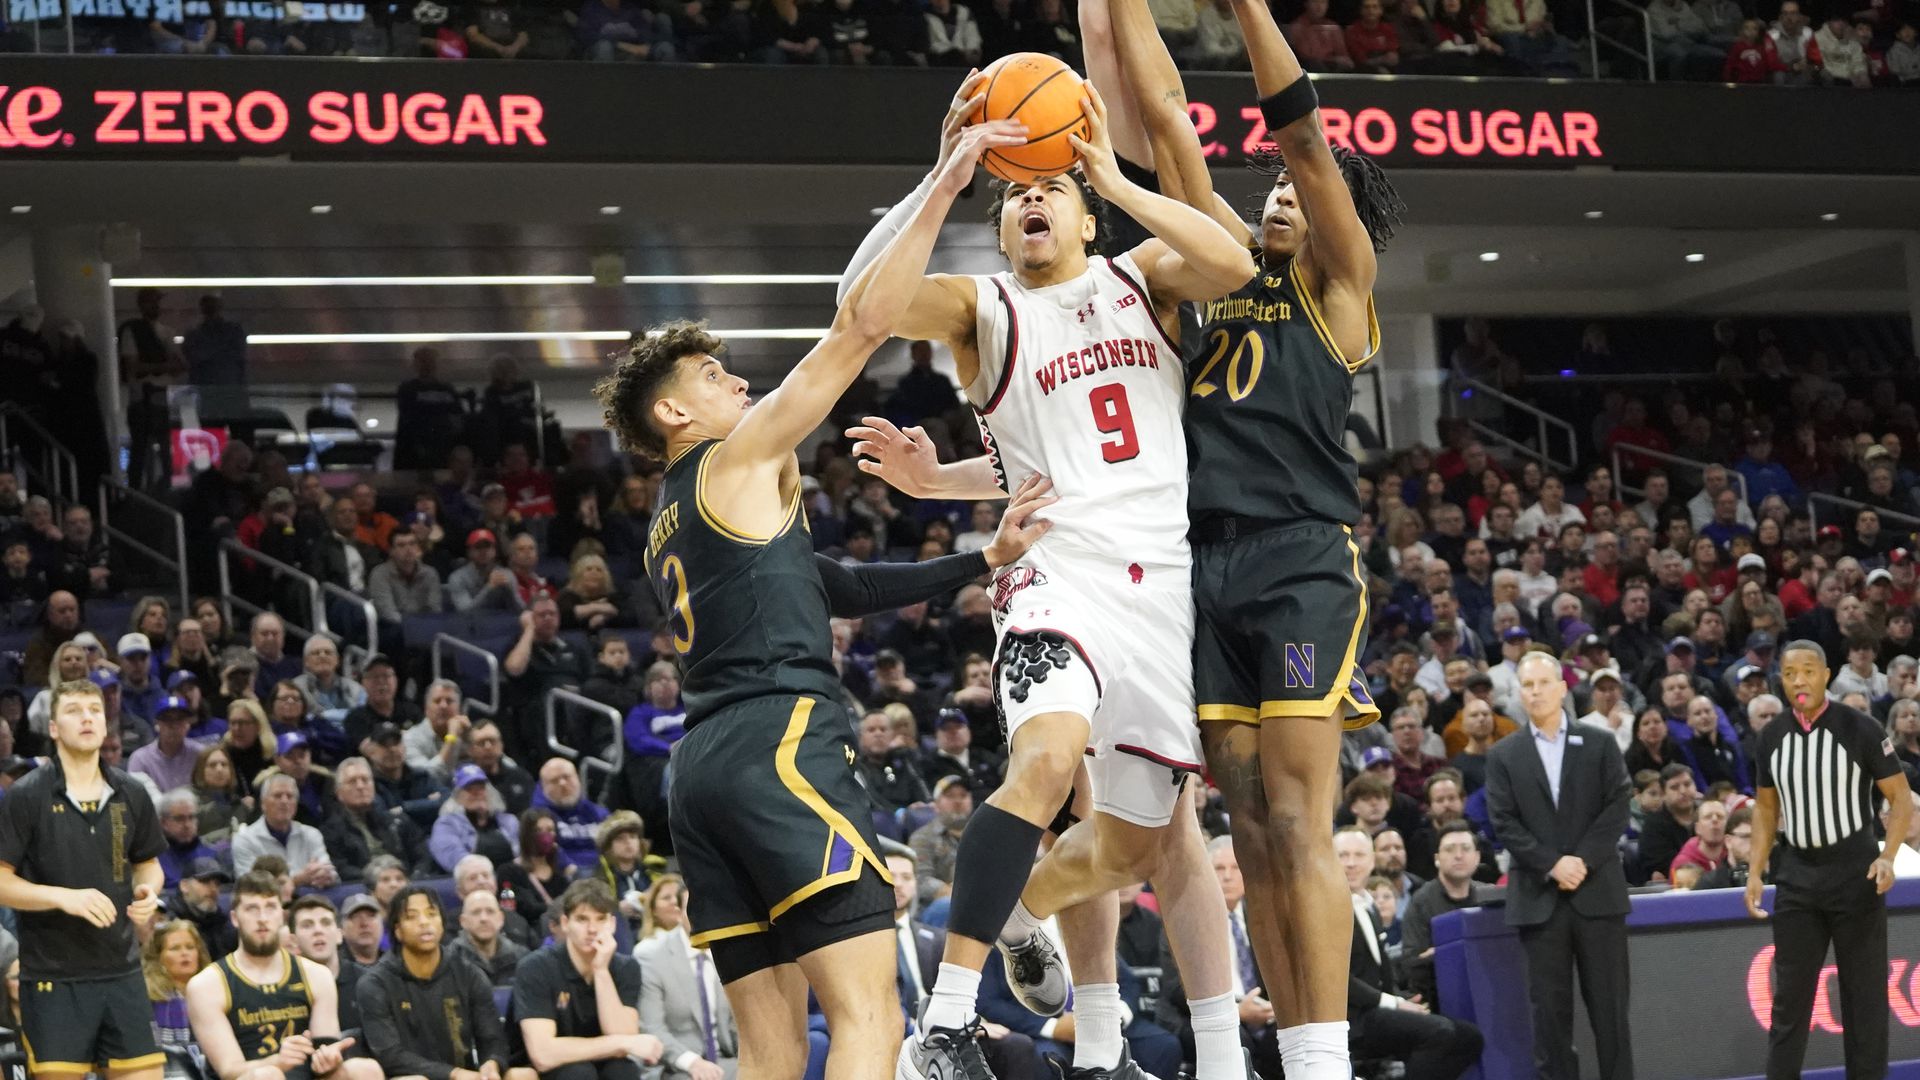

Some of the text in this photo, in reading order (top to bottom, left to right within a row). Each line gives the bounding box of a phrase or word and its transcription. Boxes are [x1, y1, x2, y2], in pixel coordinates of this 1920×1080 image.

[94, 90, 290, 144] ZERO
[307, 91, 547, 146] SUGAR
[1240, 106, 1398, 156] ZRO
[1412, 108, 1602, 157] SUGAR
[1035, 338, 1159, 396] WISCONSIN
[1191, 328, 1265, 402] 20
[1088, 382, 1141, 464] 9
[662, 554, 695, 654] 3
[1285, 643, 1314, 688] N
